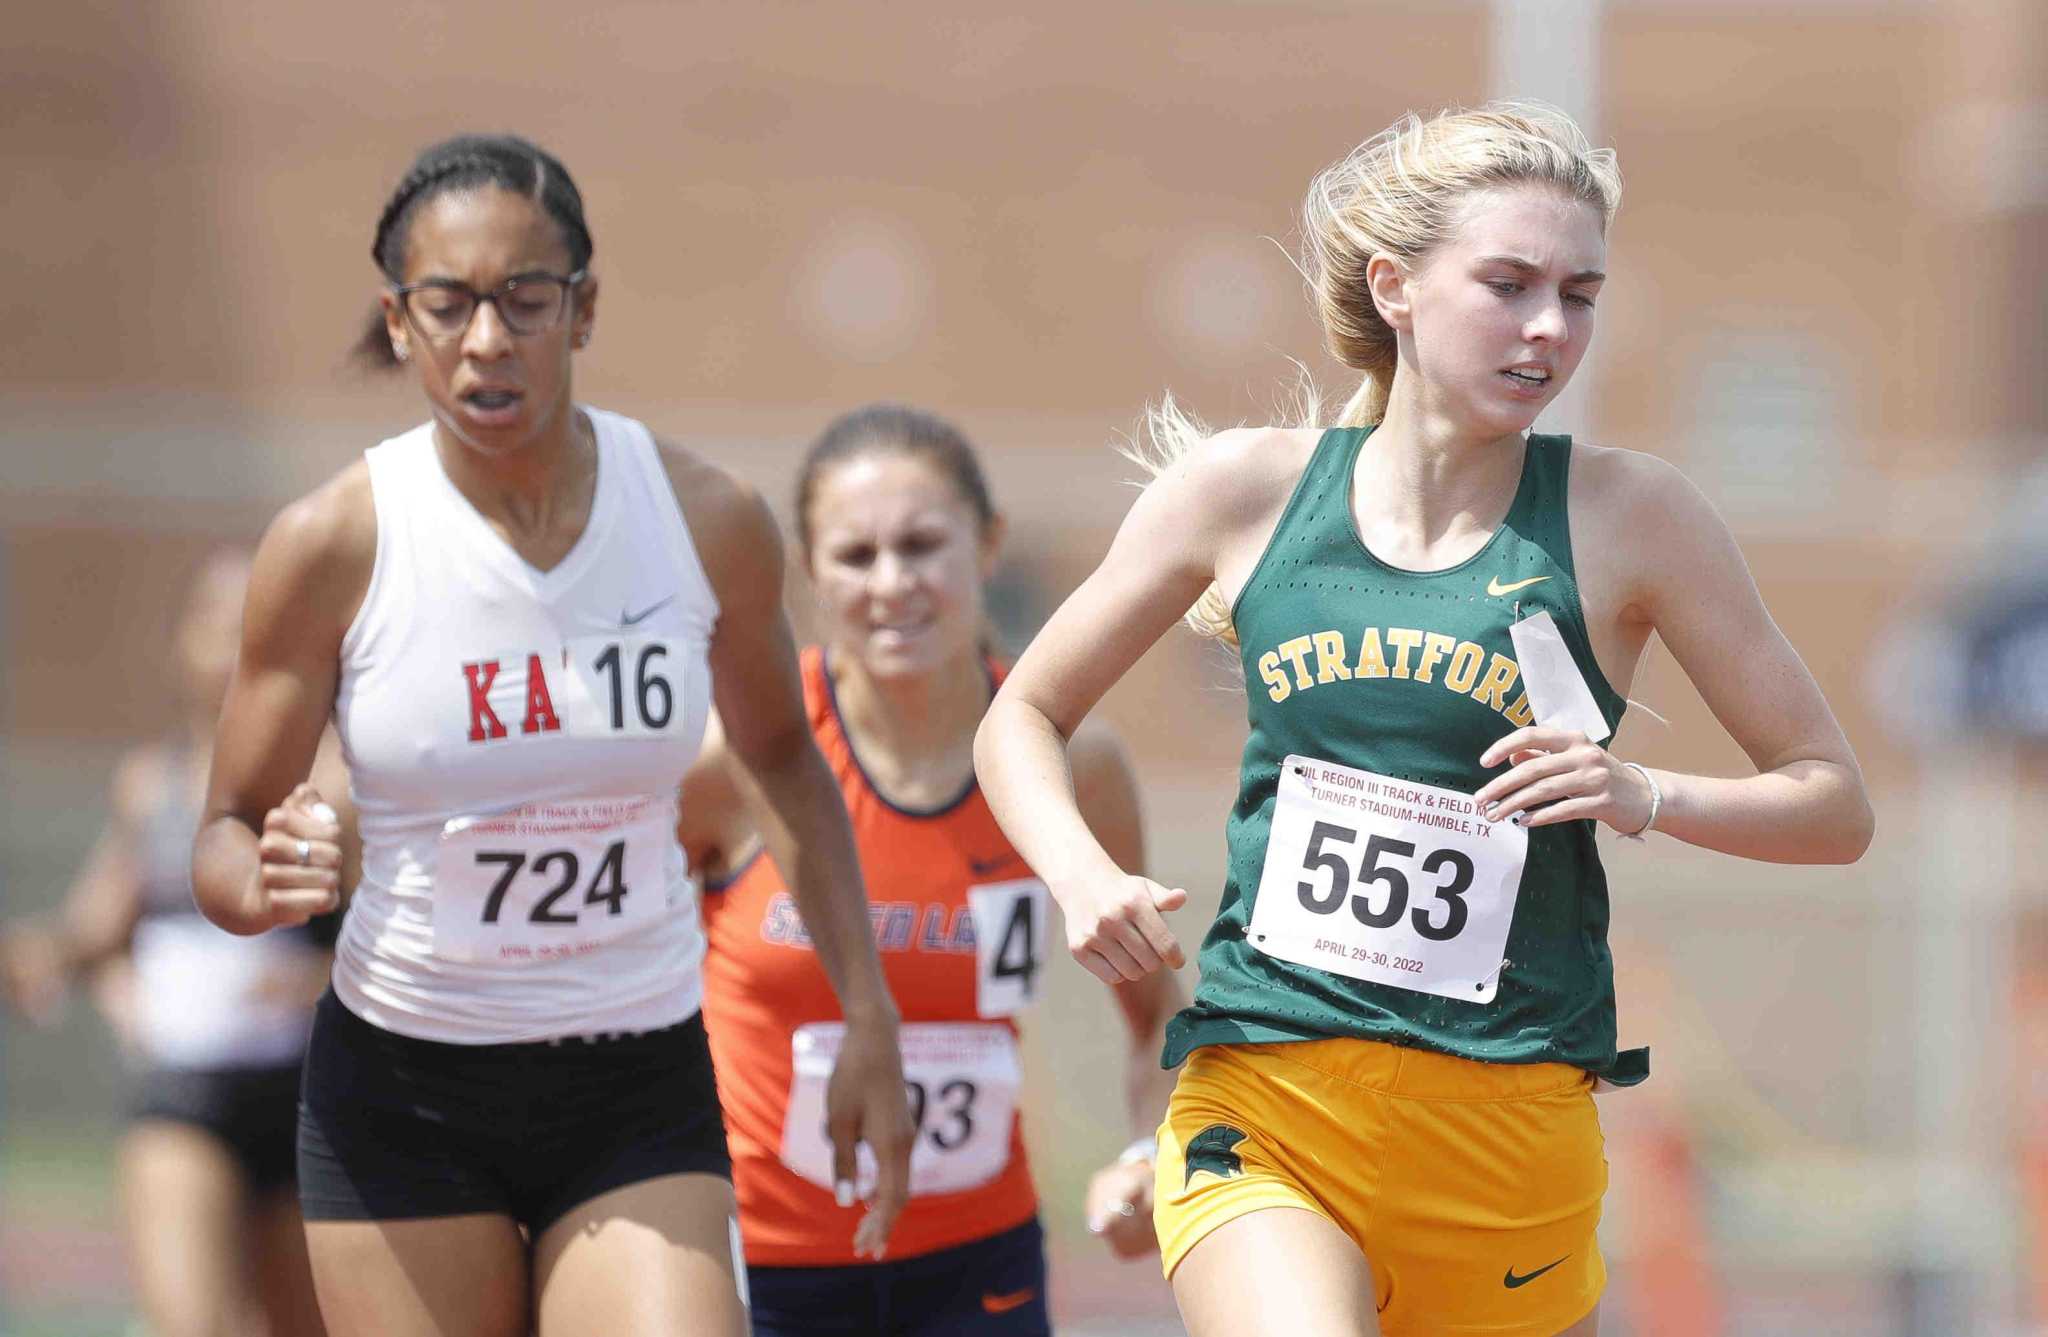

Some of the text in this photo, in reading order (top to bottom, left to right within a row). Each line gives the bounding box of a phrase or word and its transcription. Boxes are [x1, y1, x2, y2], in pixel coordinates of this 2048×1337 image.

[462, 647, 567, 743] KA
[592, 642, 673, 730] 16
[1311, 786, 1357, 808] TURNER
[1476, 824, 1492, 838] TX
[1322, 770, 1364, 791] REGION
[1367, 781, 1379, 795] III
[1383, 785, 1423, 805] TRACK
[1425, 794, 1434, 807] &
[1438, 797, 1472, 815] FIELD
[474, 839, 628, 924] 724
[1297, 820, 1475, 942] 553
[992, 895, 1038, 996] 4
[1314, 938, 1424, 974] APRIL 29-30, 2022
